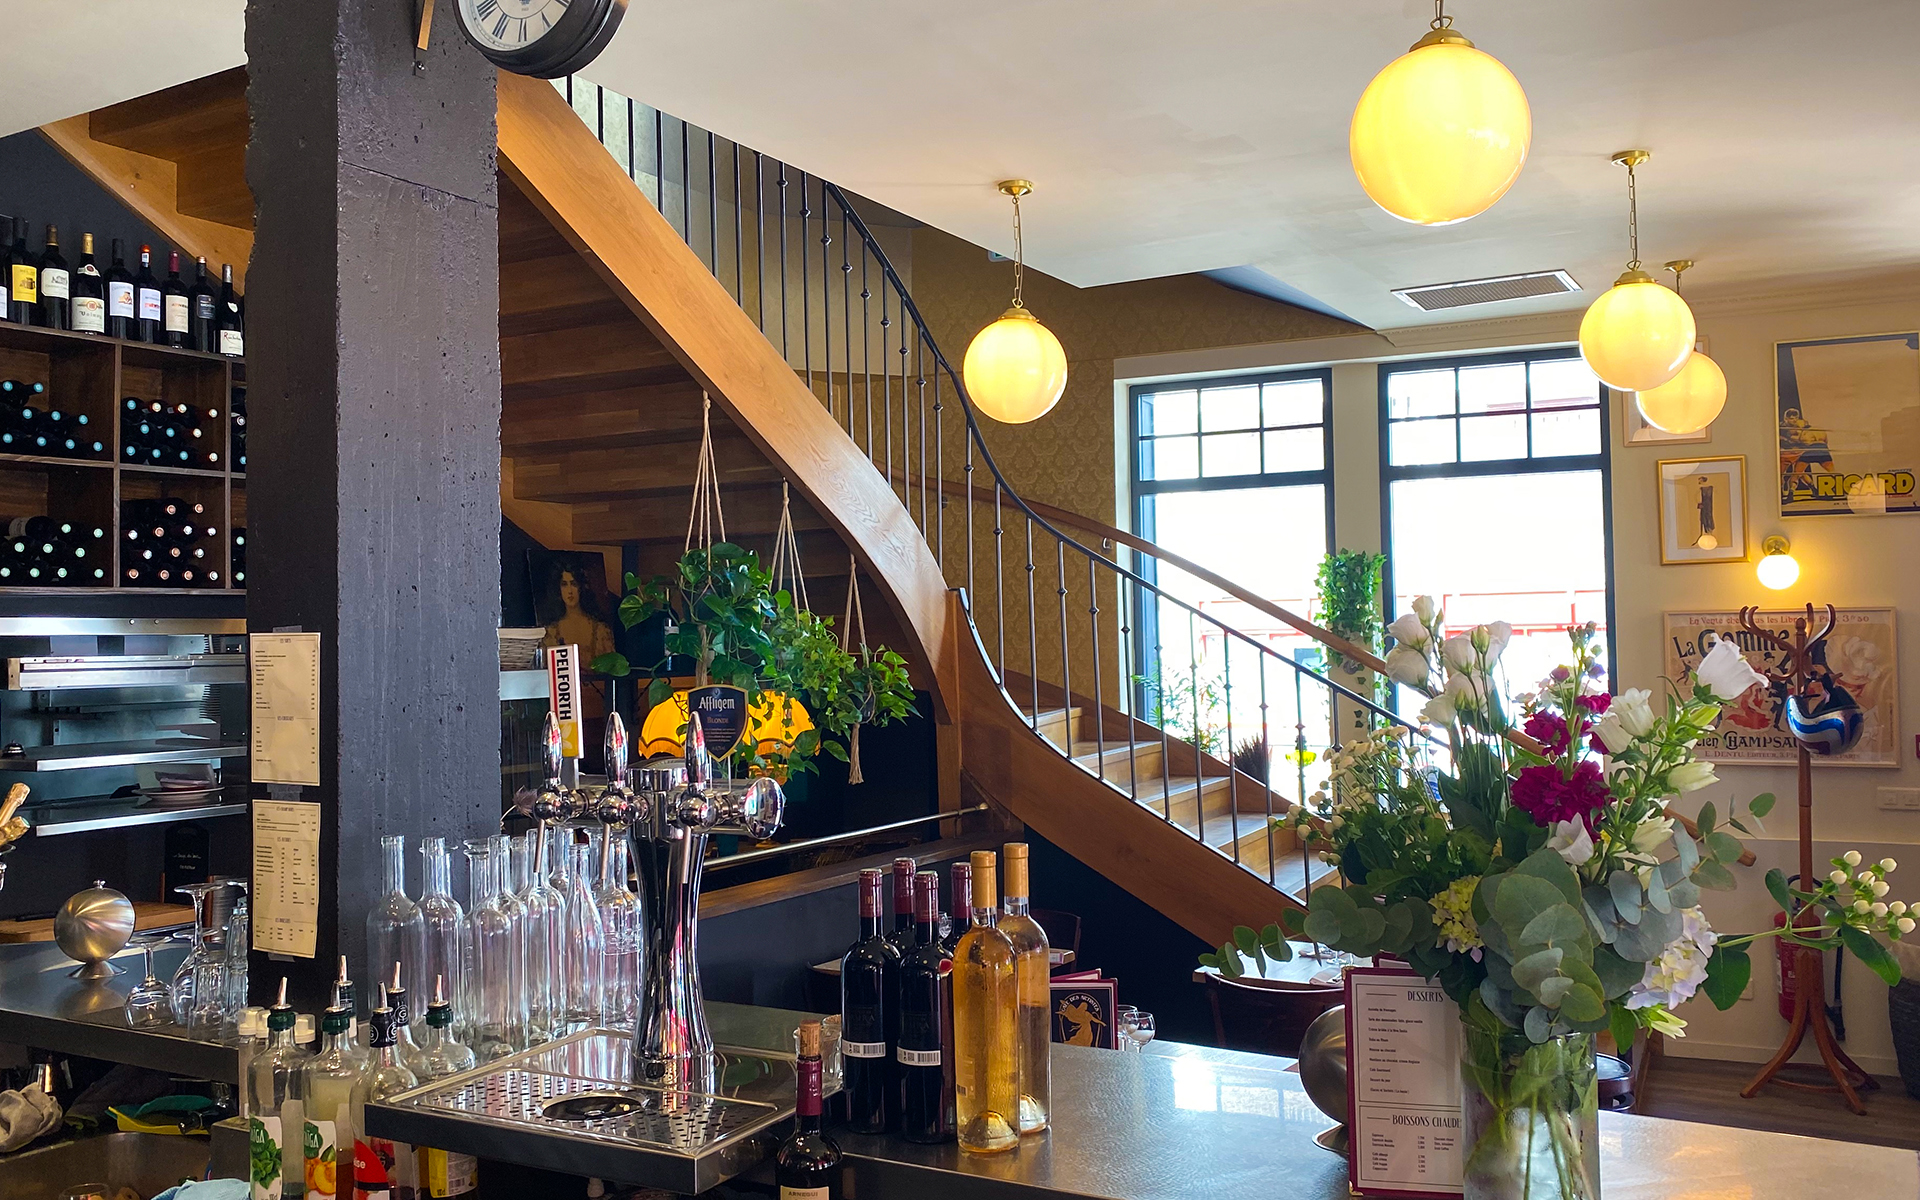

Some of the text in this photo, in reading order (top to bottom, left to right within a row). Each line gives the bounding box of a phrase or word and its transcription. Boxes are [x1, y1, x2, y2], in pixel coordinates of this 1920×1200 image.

[1817, 472, 1915, 497] RICARD
[1673, 636, 1696, 658] La
[556, 648, 572, 721] PELFORTH
[698, 696, 735, 712] Affligem
[1407, 990, 1444, 1003] DESSERTS
[1392, 1114, 1463, 1128] BOISSONS CHAUDE
